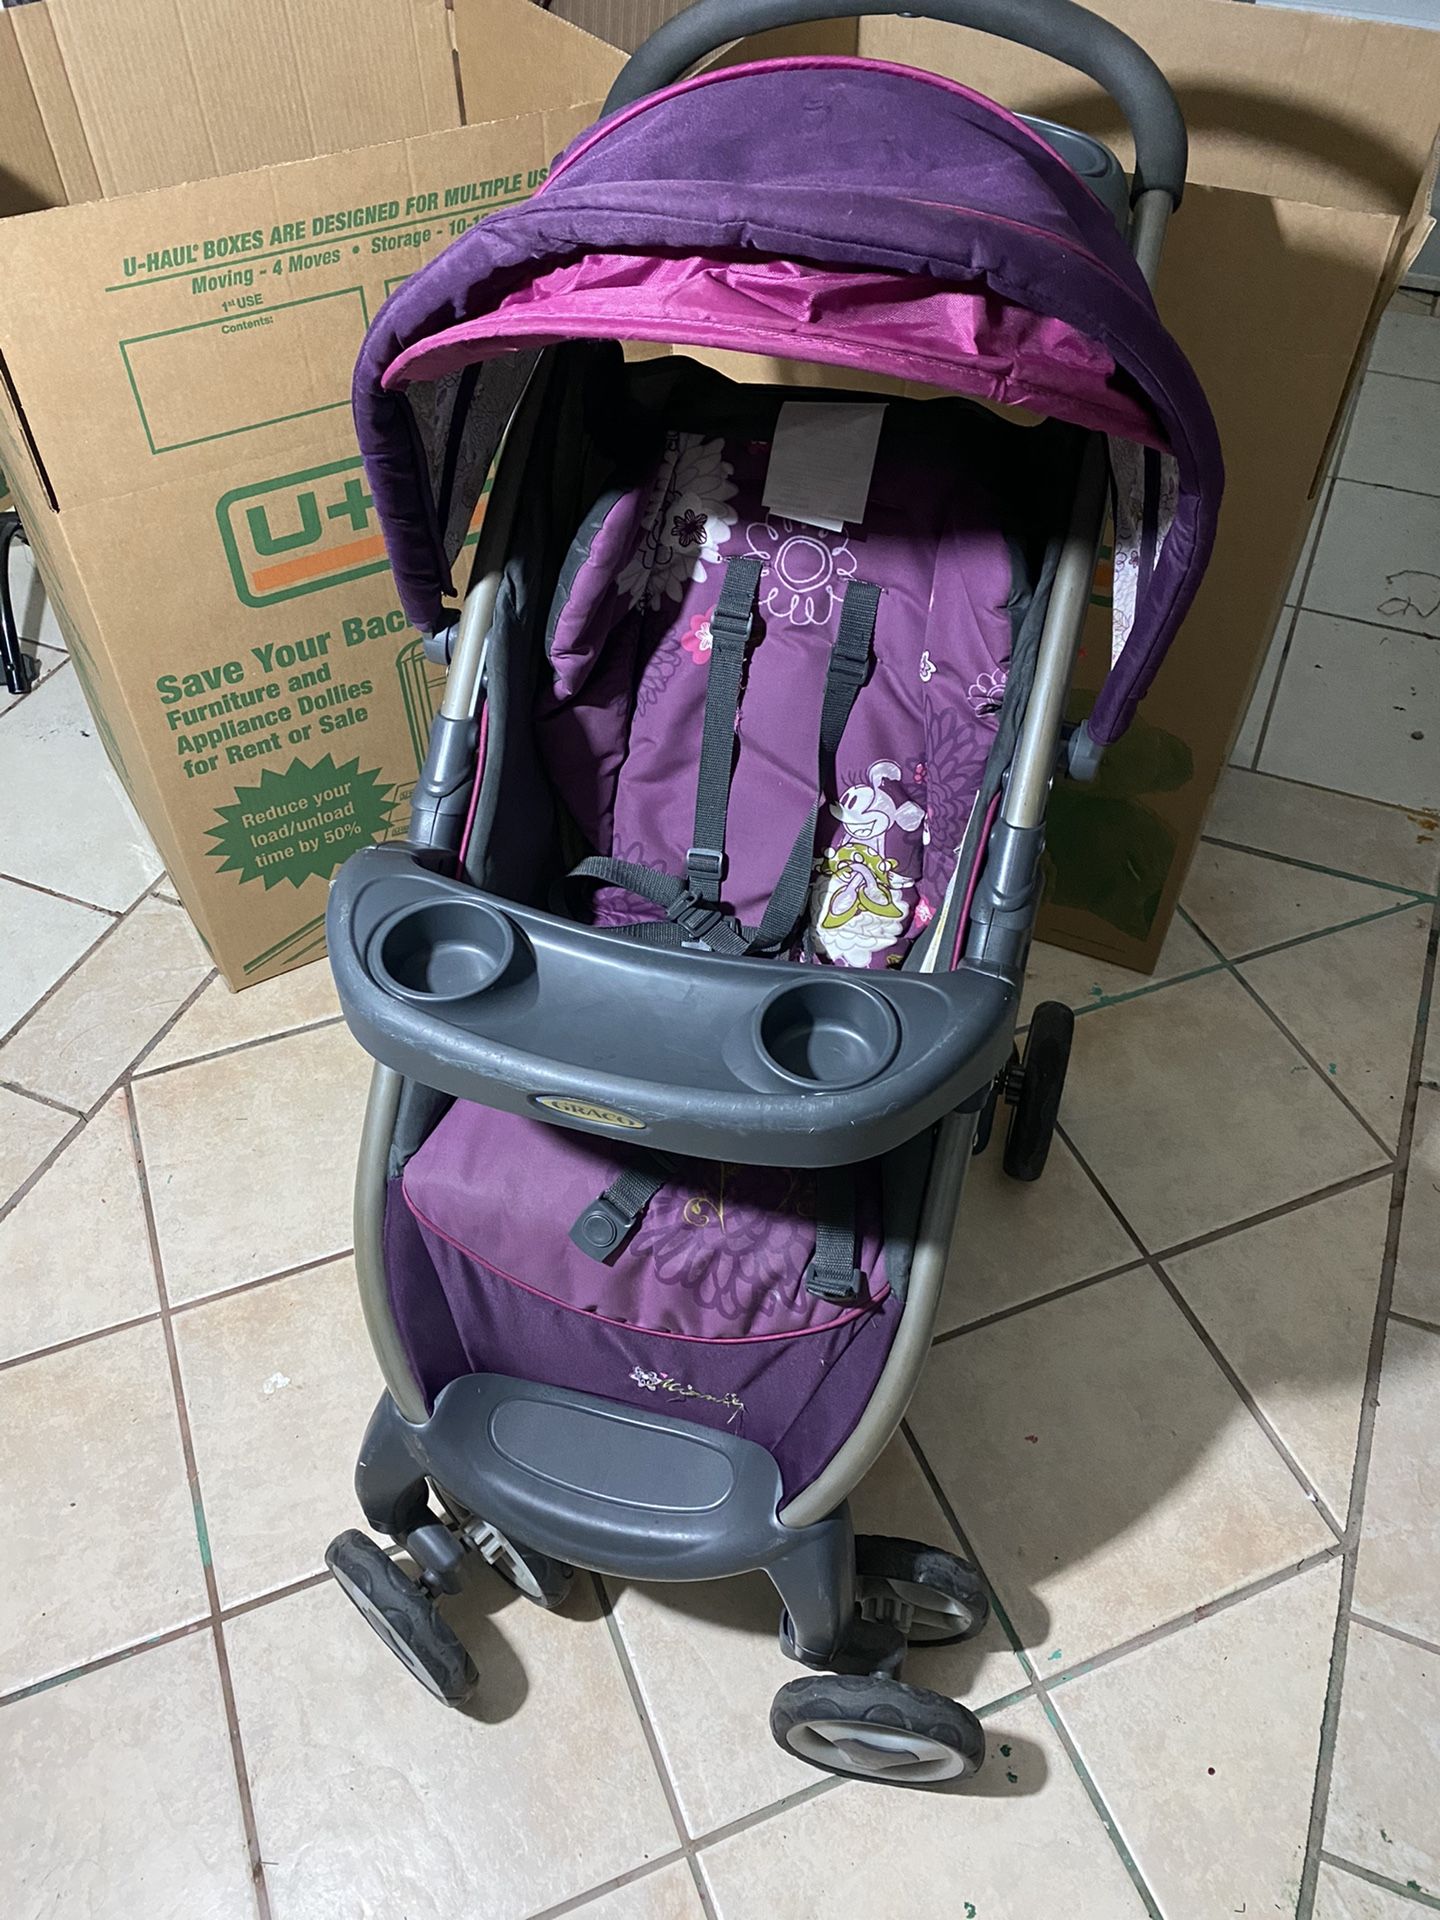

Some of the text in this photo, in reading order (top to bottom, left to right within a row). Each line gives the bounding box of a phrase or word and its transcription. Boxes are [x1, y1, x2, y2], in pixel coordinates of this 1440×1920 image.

[203, 230, 263, 260] BOXES
[269, 221, 306, 246] ARE
[312, 201, 400, 234] DESIGNED
[405, 192, 439, 216] FOR
[444, 173, 522, 208] MULTIPLE
[527, 167, 549, 189] US
[192, 268, 254, 295] Moving
[272, 259, 283, 276] 4
[288, 248, 341, 273] Moves
[371, 229, 432, 254] Storage
[221, 315, 274, 335] Contents:
[237, 293, 264, 309] USE
[156, 660, 245, 705] Save
[250, 632, 332, 675] Your
[166, 662, 332, 731] Furniture and
[177, 678, 374, 754] Appliance Dollies
[183, 706, 369, 778] for Rent or Sale
[240, 780, 353, 830] Reduce your
[250, 803, 355, 849] load/unload
[254, 820, 363, 868] time by 50%
[551, 1100, 635, 1126] GRACO
